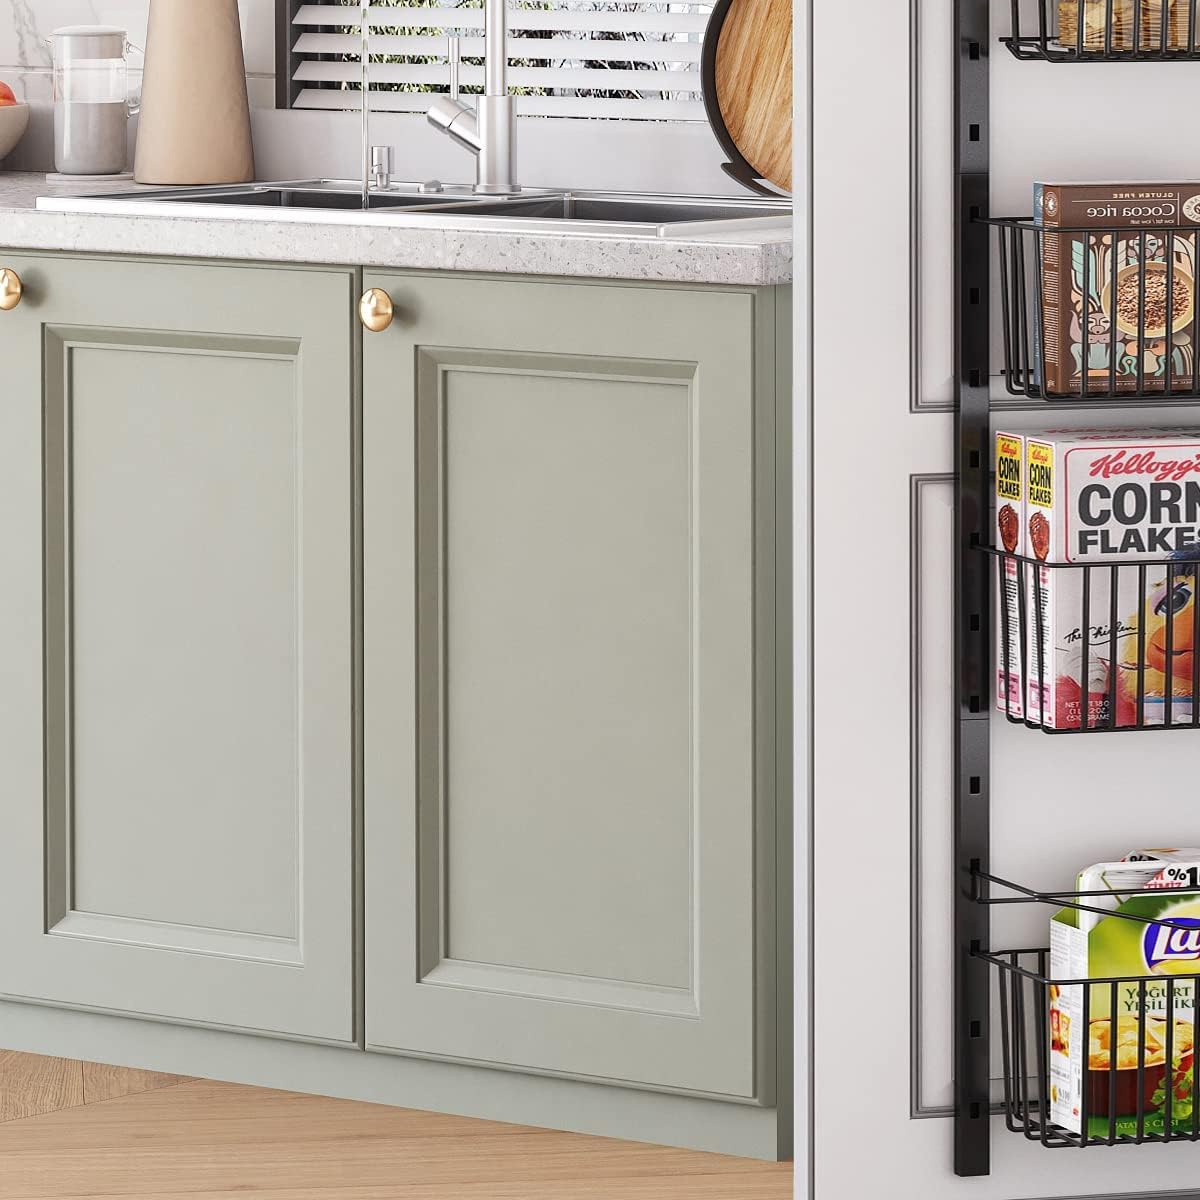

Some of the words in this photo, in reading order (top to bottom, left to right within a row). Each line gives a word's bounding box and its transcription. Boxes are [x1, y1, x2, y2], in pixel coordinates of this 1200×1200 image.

[998, 456, 1020, 482] CORN
[1029, 463, 1052, 489] CORN
[998, 479, 1020, 498] FLAKES
[1029, 486, 1052, 505] FLAKES
